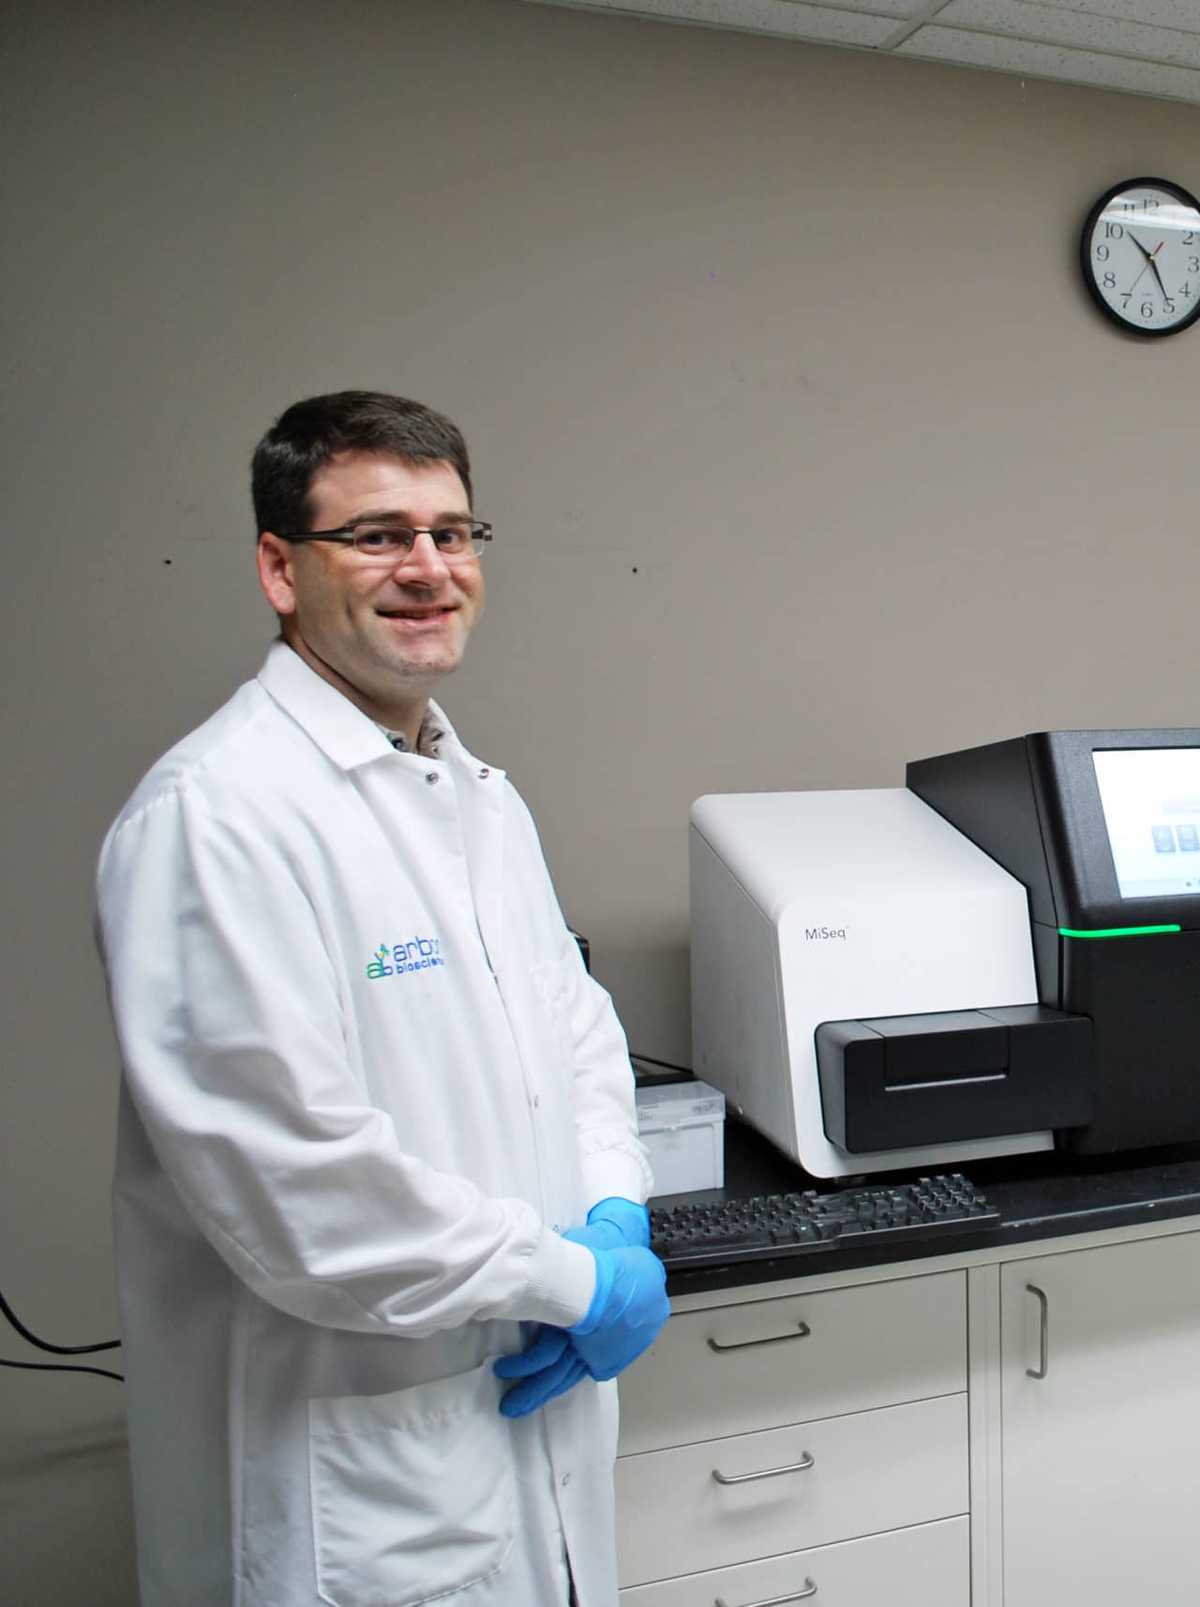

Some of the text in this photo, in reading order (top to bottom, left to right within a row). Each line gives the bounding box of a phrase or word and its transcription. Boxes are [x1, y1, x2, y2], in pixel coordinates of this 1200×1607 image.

[1105, 222, 1124, 240] 10
[1182, 230, 1194, 246] 2
[1096, 245, 1110, 262] 9
[1187, 256, 1200, 273] 3
[1103, 271, 1116, 289] 8
[1178, 281, 1191, 298] 4
[1120, 292, 1132, 309] 7
[1163, 297, 1175, 314] 5
[1140, 301, 1153, 318] 6
[805, 926, 847, 941] MiSeq
